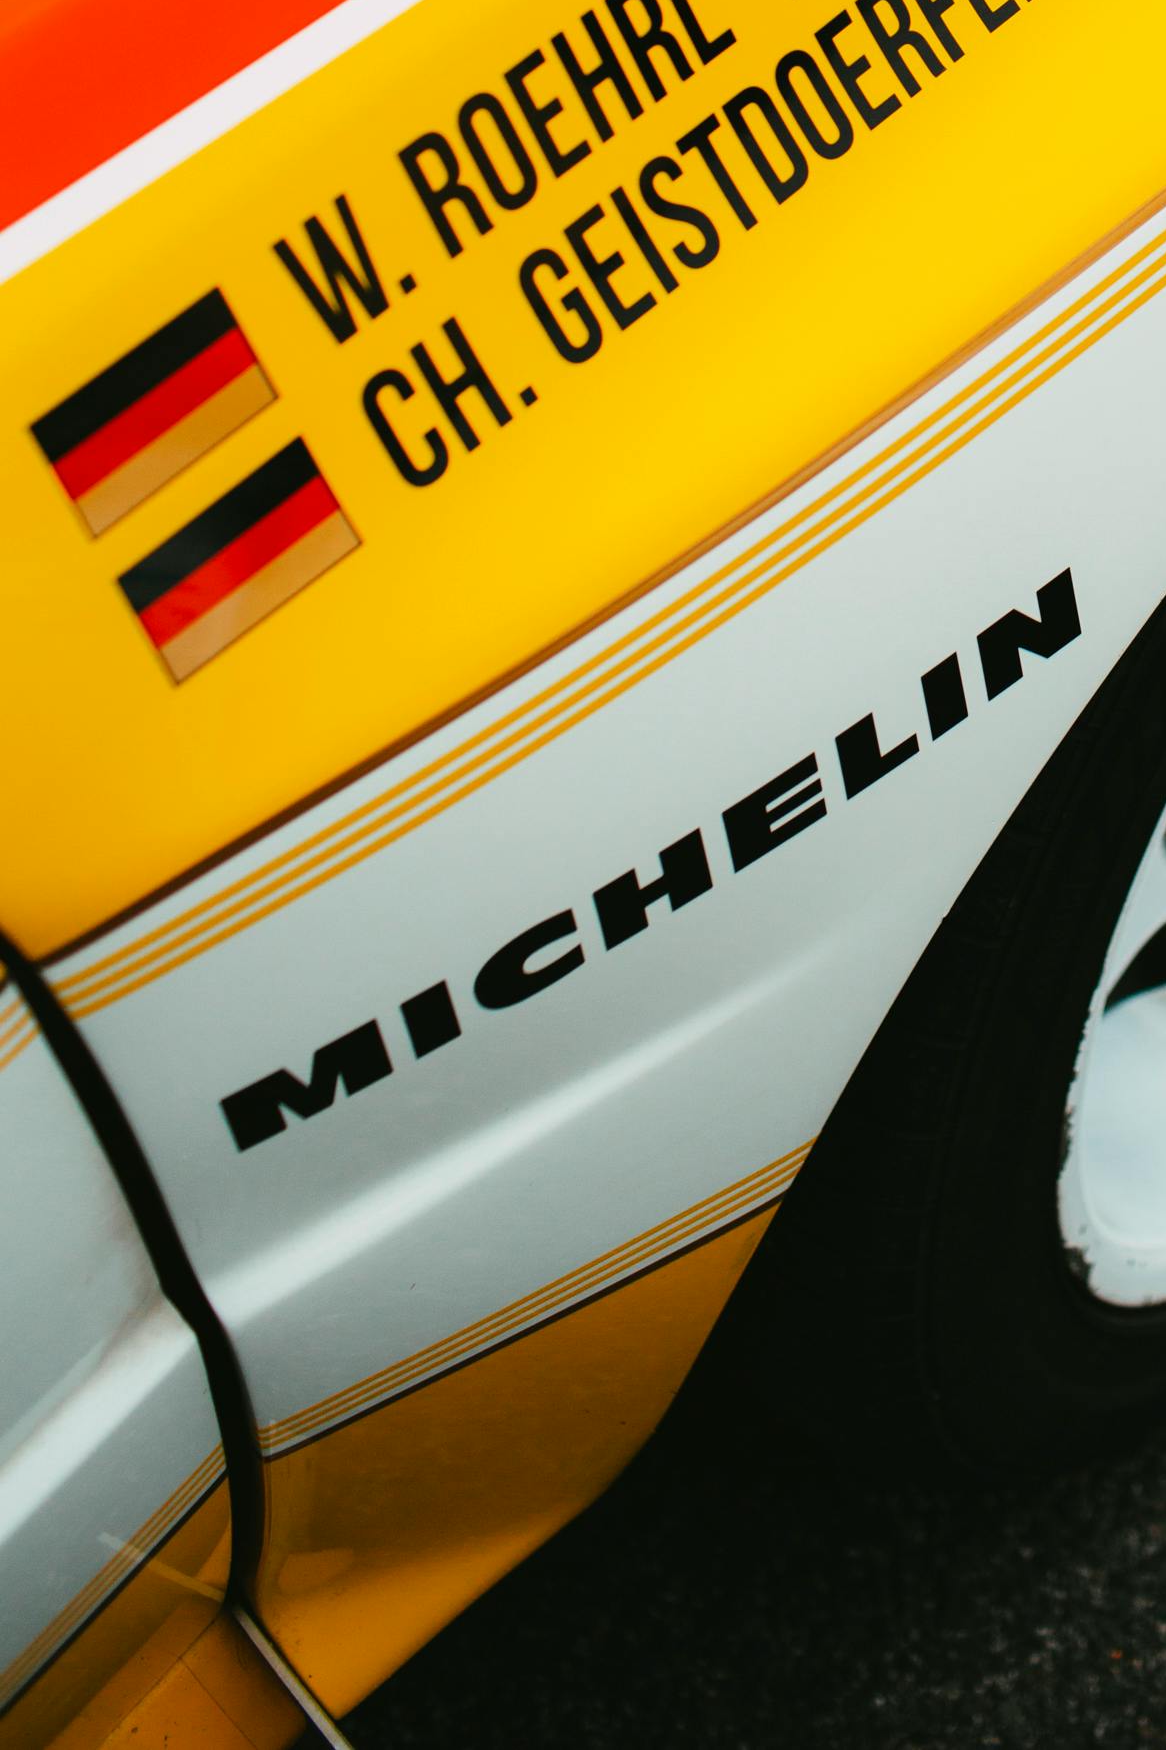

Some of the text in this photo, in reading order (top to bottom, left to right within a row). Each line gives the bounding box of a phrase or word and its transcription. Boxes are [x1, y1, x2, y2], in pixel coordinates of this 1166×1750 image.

[271, 193, 419, 345] W.
[360, 315, 540, 488] CH.
[219, 566, 1083, 1153] MICHELIN
